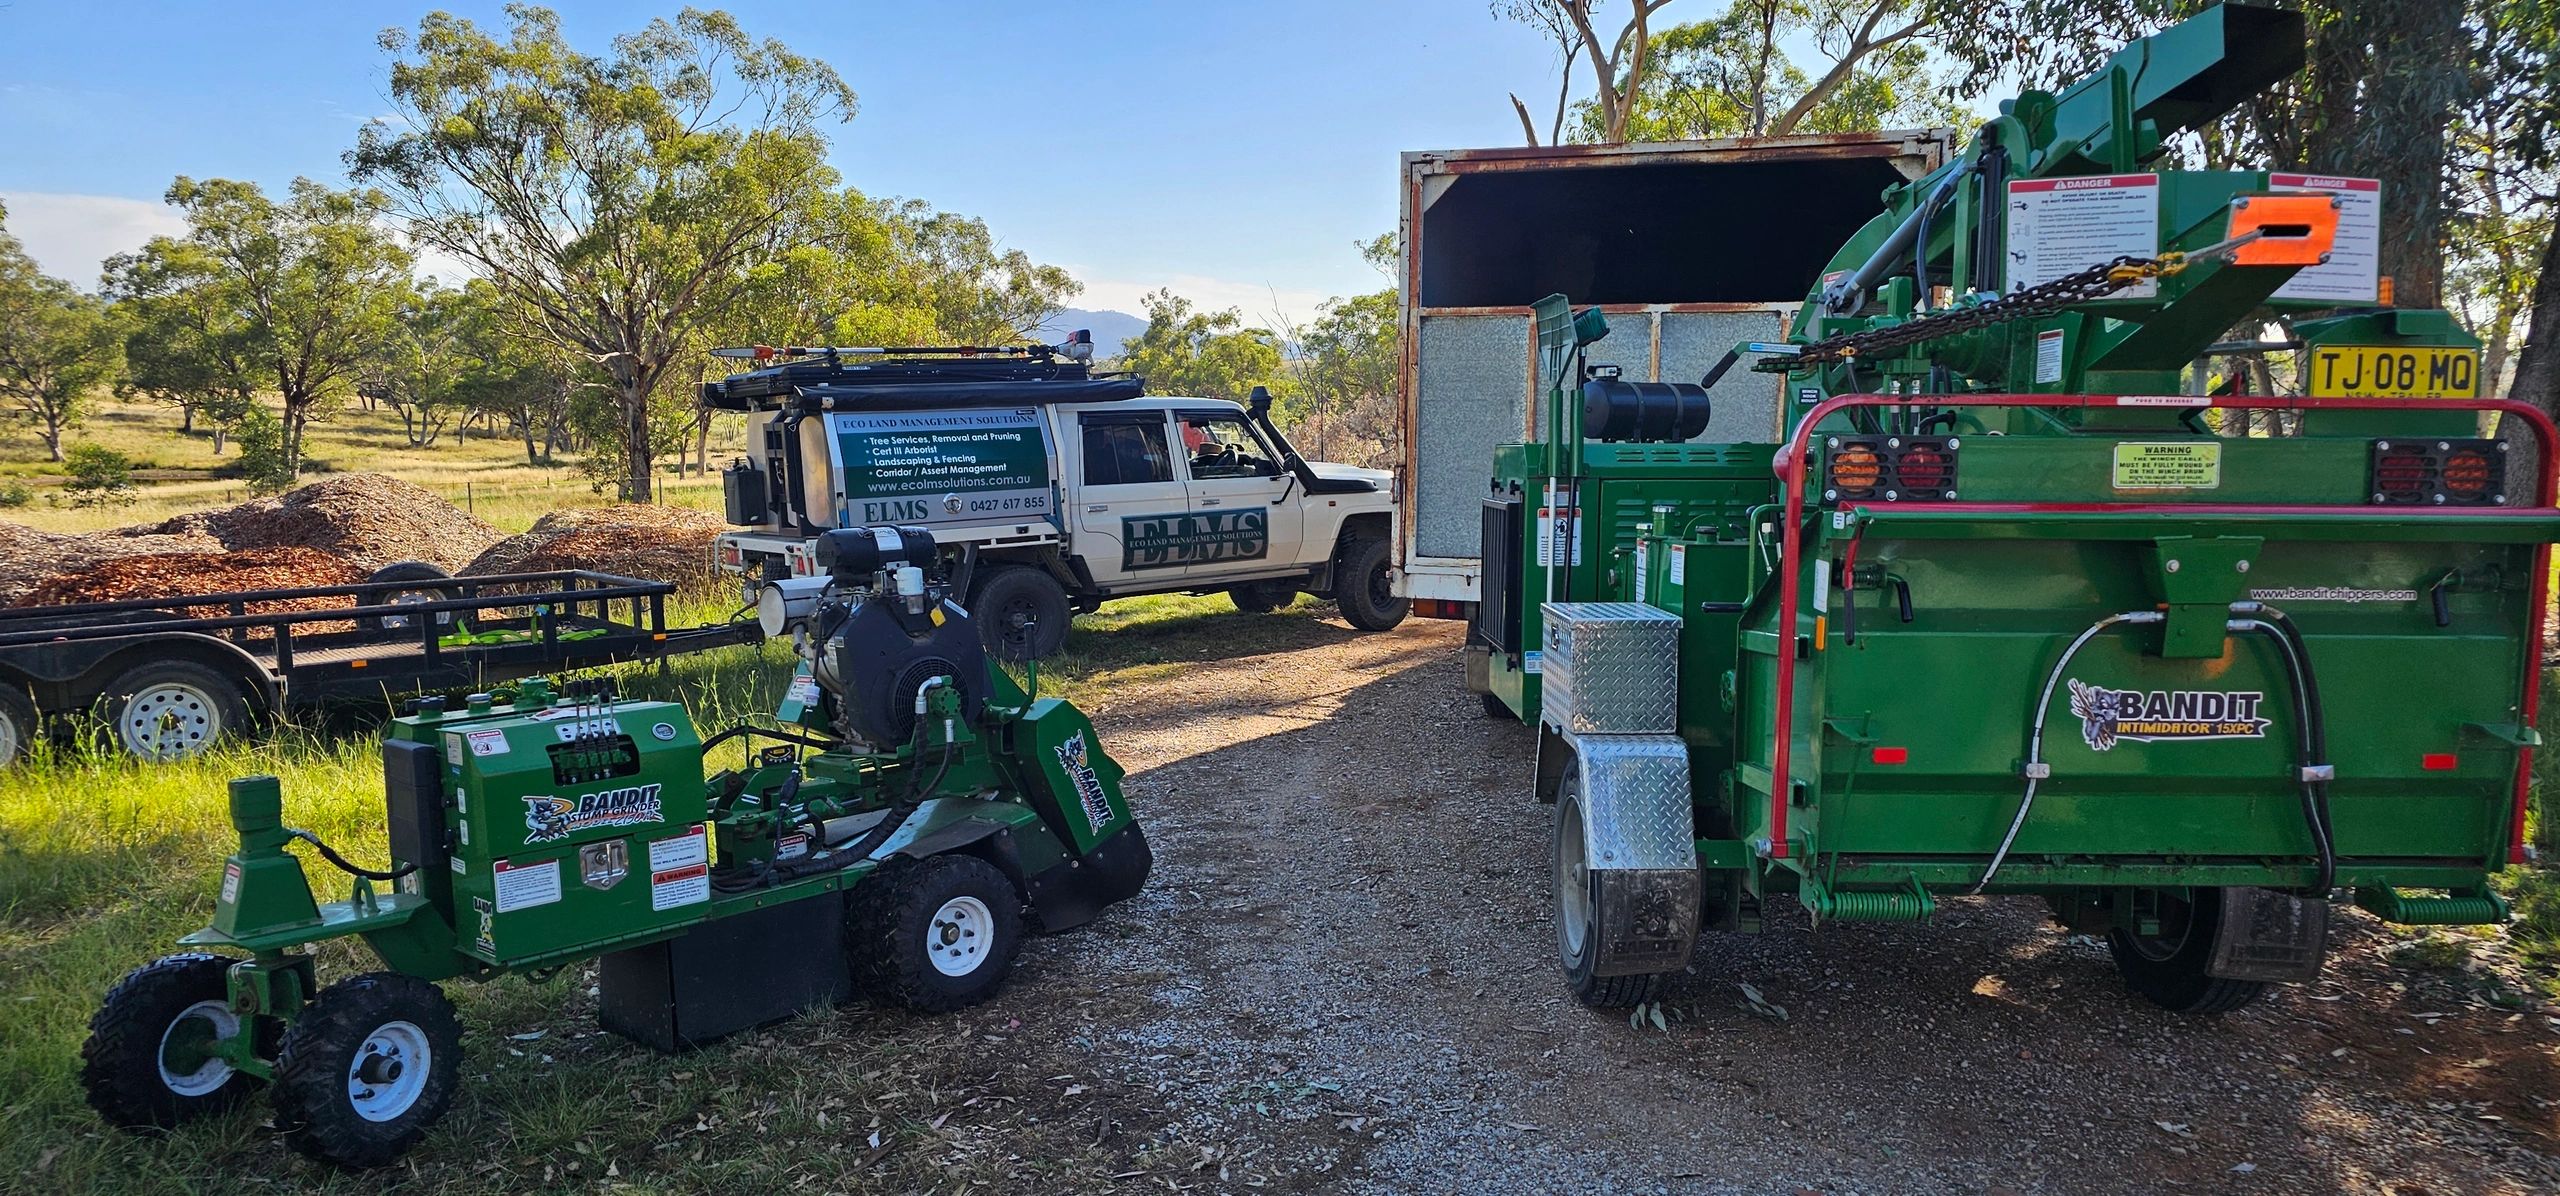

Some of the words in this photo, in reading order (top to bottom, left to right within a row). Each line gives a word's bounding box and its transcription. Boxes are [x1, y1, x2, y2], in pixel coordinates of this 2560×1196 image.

[2067, 179, 2111, 189] DANGER
[2313, 179, 2347, 188] DANGER
[843, 420, 866, 429] ECO
[869, 418, 897, 428] LAND
[900, 416, 973, 427] MANAGEMENT
[977, 414, 1034, 425] SOLUTIONS
[869, 437, 889, 445] Tree
[892, 435, 931, 445] Services,
[932, 433, 970, 443] Removal
[972, 433, 988, 442] and
[990, 432, 1021, 442] Pruning
[872, 447, 892, 456] Cert
[904, 445, 937, 455] Arborist
[2144, 446, 2192, 454] WARNING
[874, 456, 932, 467] Landscaping
[934, 456, 940, 464] &
[942, 455, 976, 465] Fencing
[876, 468, 912, 478] Corridor
[921, 467, 948, 476] Assest
[950, 464, 1007, 475] Management
[868, 475, 1031, 493] www.ecolmsolutions.com.au
[863, 500, 929, 523] ELMS
[970, 499, 999, 512] 0427
[1003, 498, 1020, 510] 617
[1024, 496, 1045, 508] 855
[1128, 511, 1264, 566] ELMS
[1129, 540, 1146, 548] ECO
[1148, 538, 1167, 546] LAND
[1168, 534, 1221, 545] MANAGEMENT
[1222, 530, 1263, 540] SOLUTIONS
[2252, 587, 2416, 602] www.banditchippers.com
[2119, 692, 2262, 721] BANDIT
[2116, 722, 2209, 735] INTIMIDATOR
[2216, 722, 2254, 735] 15XPC
[579, 784, 661, 812] BANDIT
[1081, 767, 1114, 821] BANDIT
[571, 808, 609, 823] STUMP
[612, 800, 660, 816] GRINDER
[667, 868, 702, 880] WARNING
